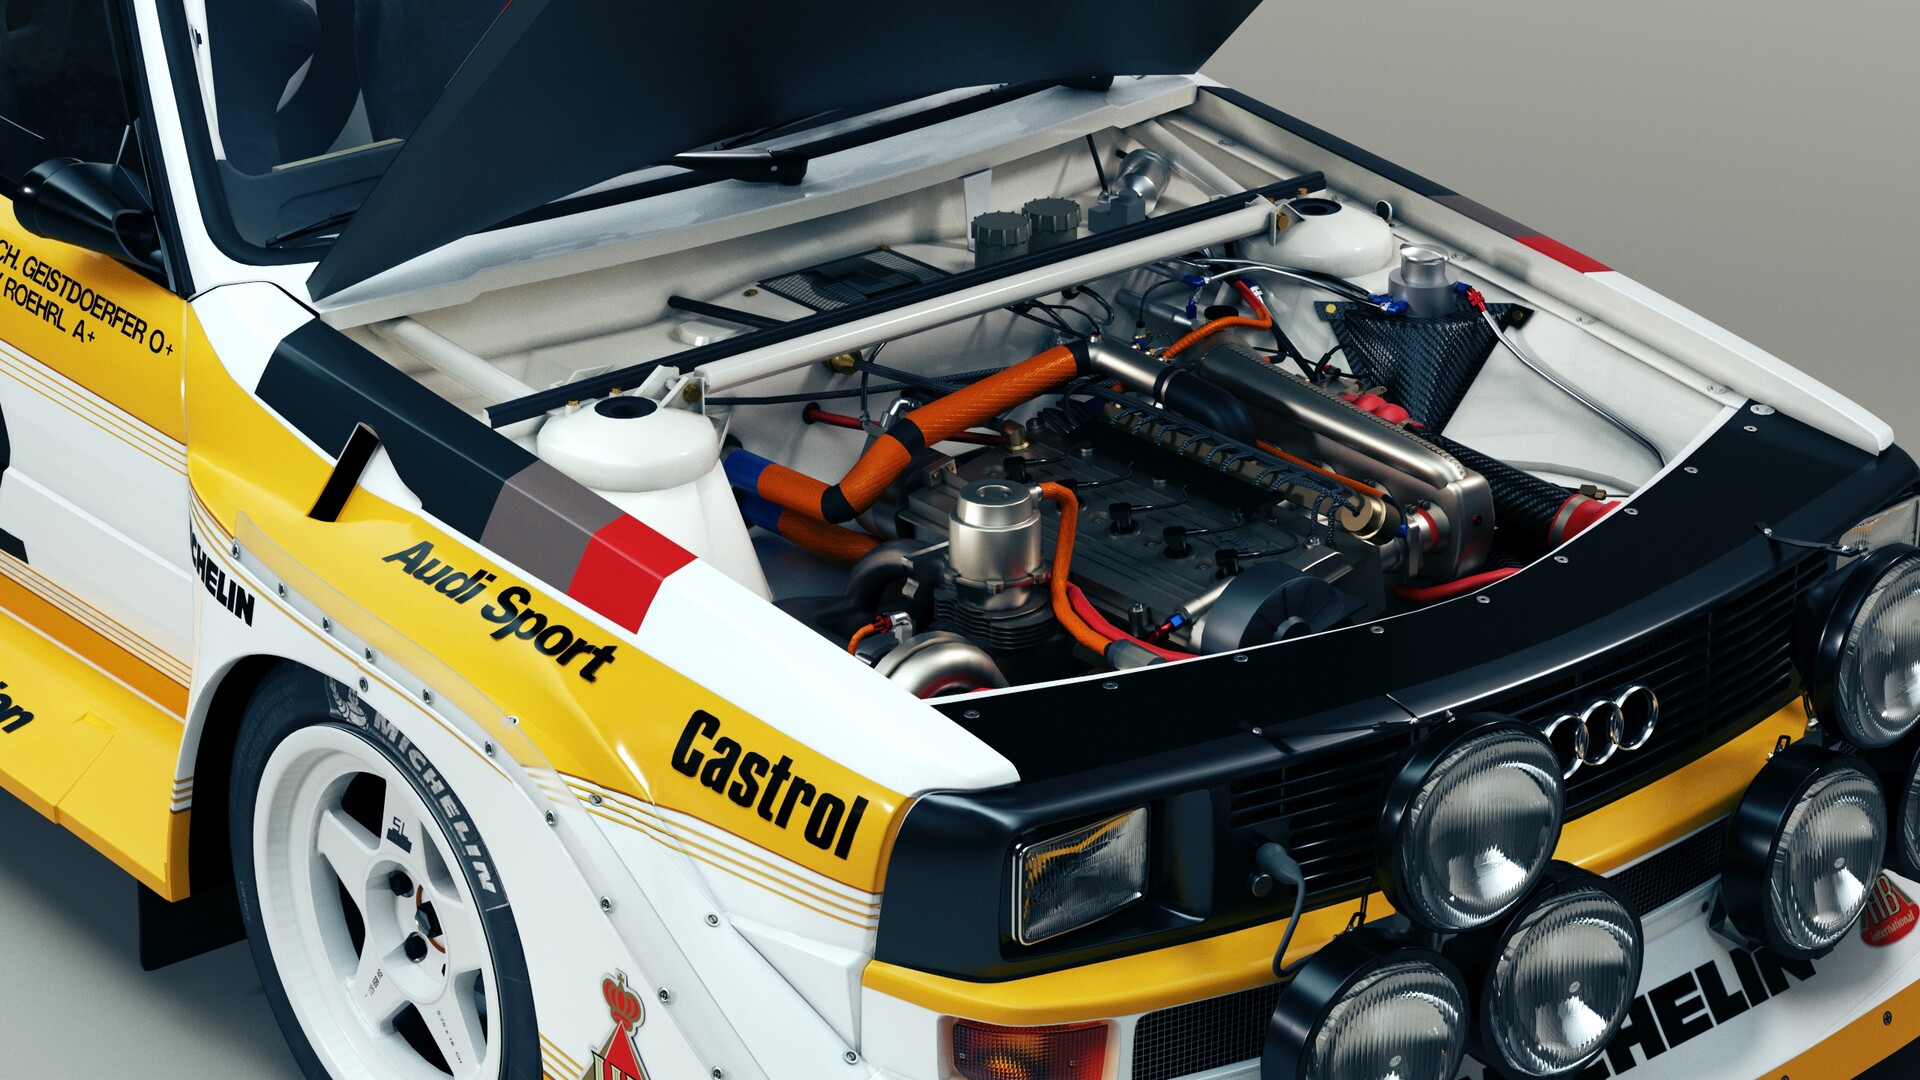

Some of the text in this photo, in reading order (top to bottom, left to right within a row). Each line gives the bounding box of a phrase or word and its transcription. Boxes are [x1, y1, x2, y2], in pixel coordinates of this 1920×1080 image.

[4, 276, 95, 343] ROEHRL A+
[22, 255, 148, 344] GEISTDOERFER
[382, 540, 618, 683] Audi Sport
[373, 710, 497, 894] MICHELIN
[671, 709, 870, 861] Castrol
[1869, 909, 1916, 943] international
